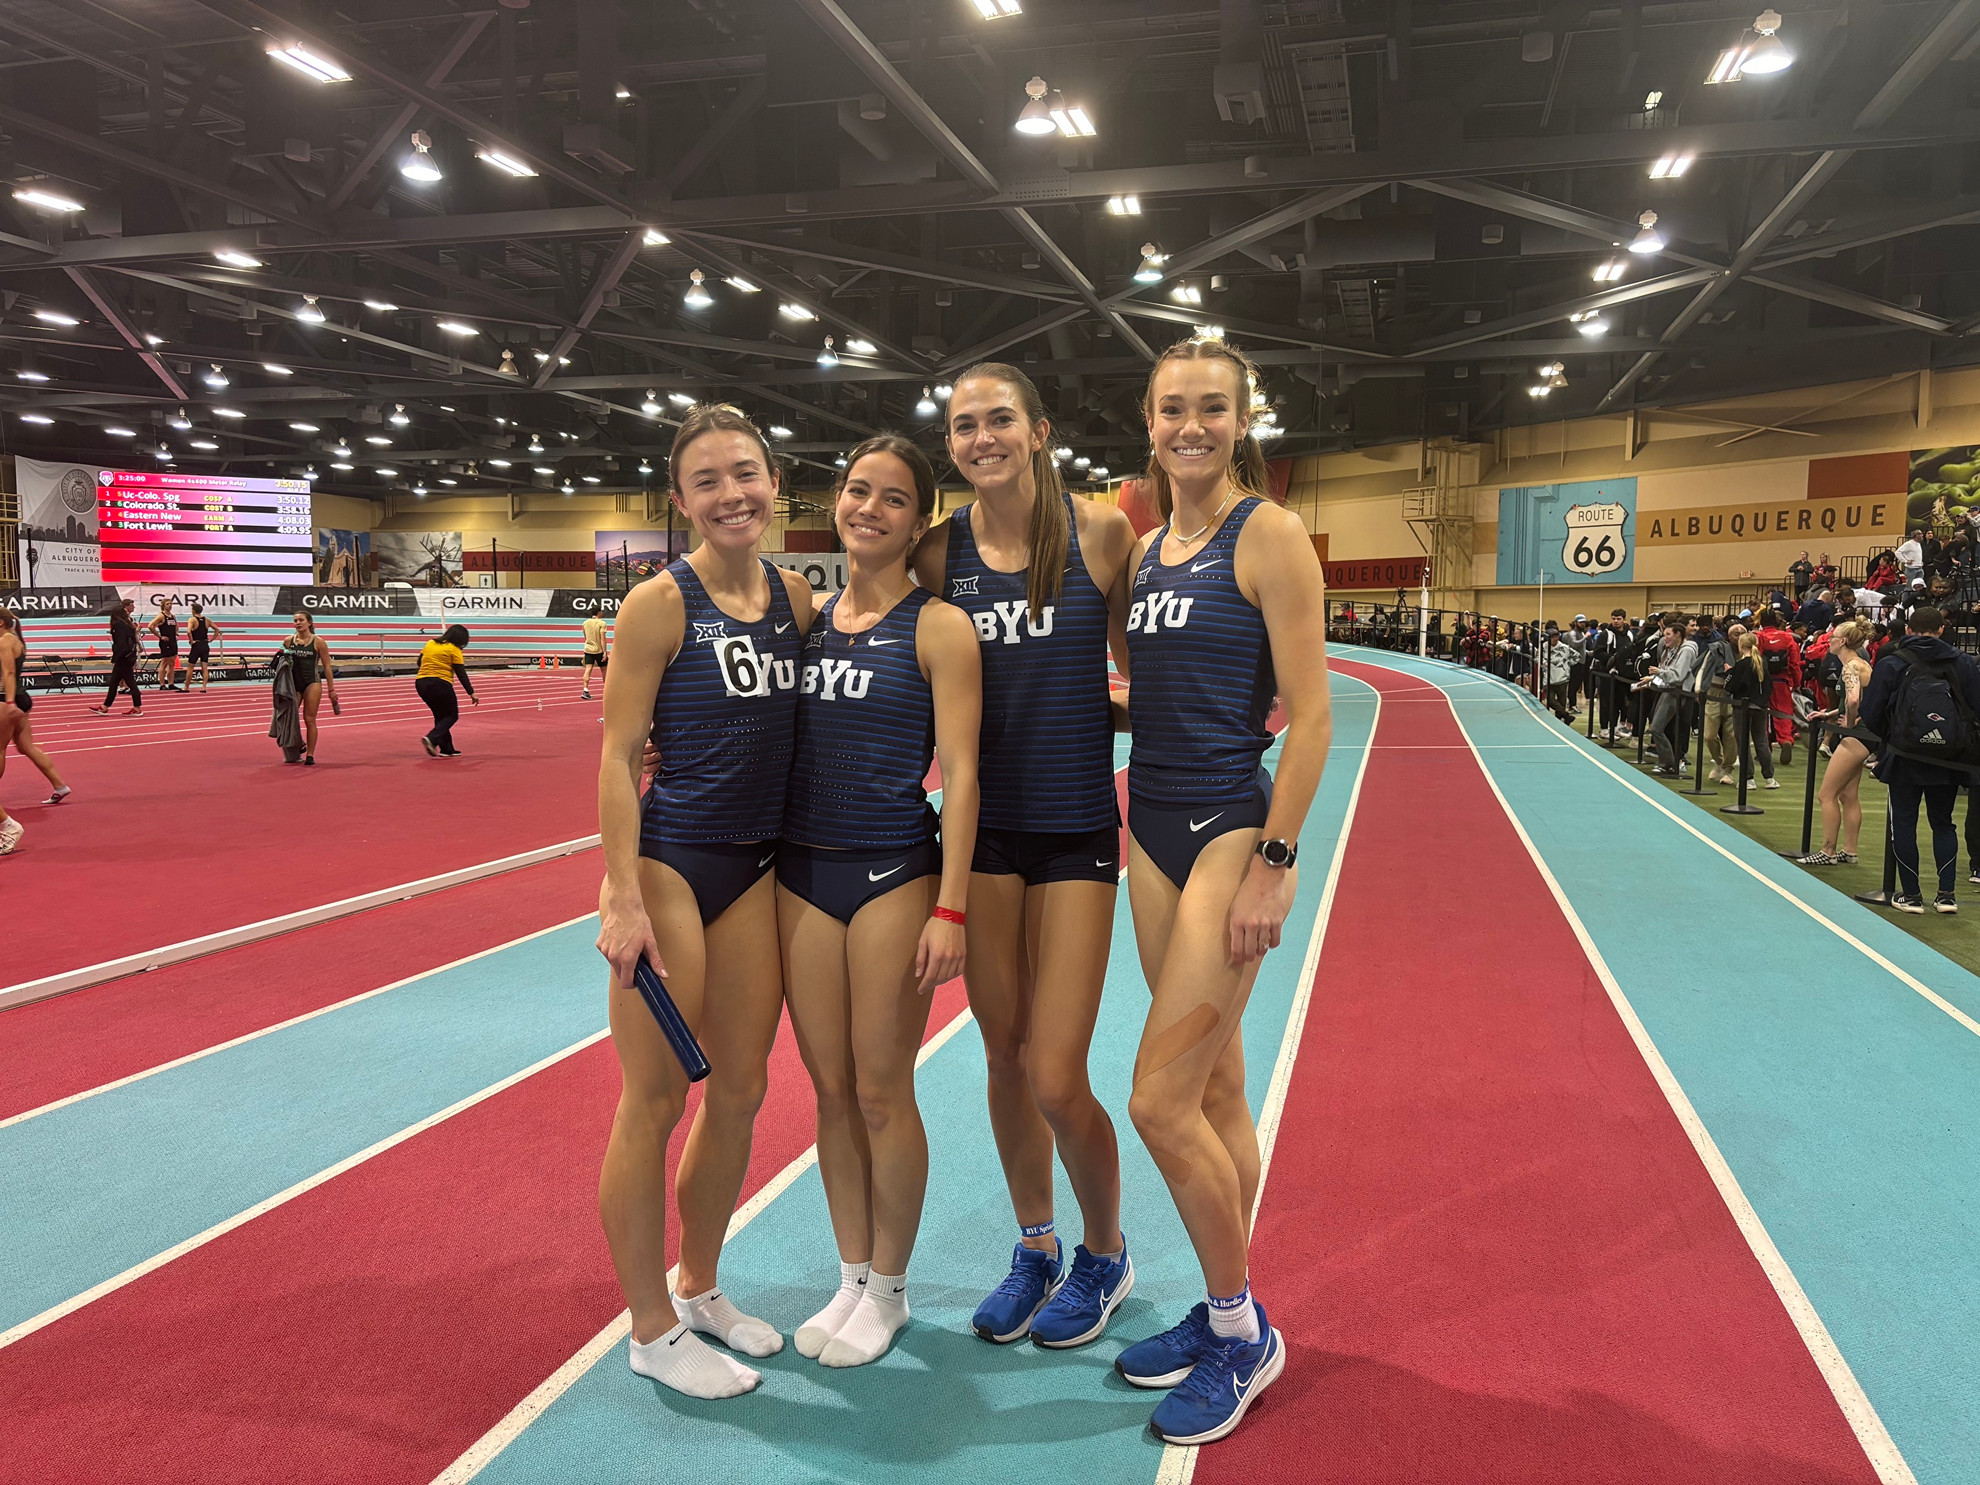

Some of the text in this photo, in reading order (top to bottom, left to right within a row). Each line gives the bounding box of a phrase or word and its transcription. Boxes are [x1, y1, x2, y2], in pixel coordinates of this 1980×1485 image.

[123, 491, 161, 500] Uc-Colo.
[163, 492, 180, 502] Spg
[123, 501, 164, 510] Colorado
[166, 502, 180, 510] St.
[123, 511, 158, 519] Eastern
[160, 512, 182, 520] New
[1578, 508, 1614, 522] ROUTE
[1650, 504, 1886, 538] ALBUQUERQUE
[123, 521, 145, 530] Fort
[146, 522, 173, 531] Lewis
[1573, 534, 1616, 568] 66
[0, 594, 90, 610] ARMIN
[302, 594, 390, 609] GARMIN
[442, 596, 523, 609] GARMIN
[1126, 590, 1194, 634] BYU
[973, 599, 1055, 645] BYU
[723, 640, 758, 693] 6
[191, 670, 227, 680] GAMIN
[800, 658, 874, 701] BYU
[1919, 737, 1946, 745] adidas
[1026, 1226, 1039, 1235] BYU
